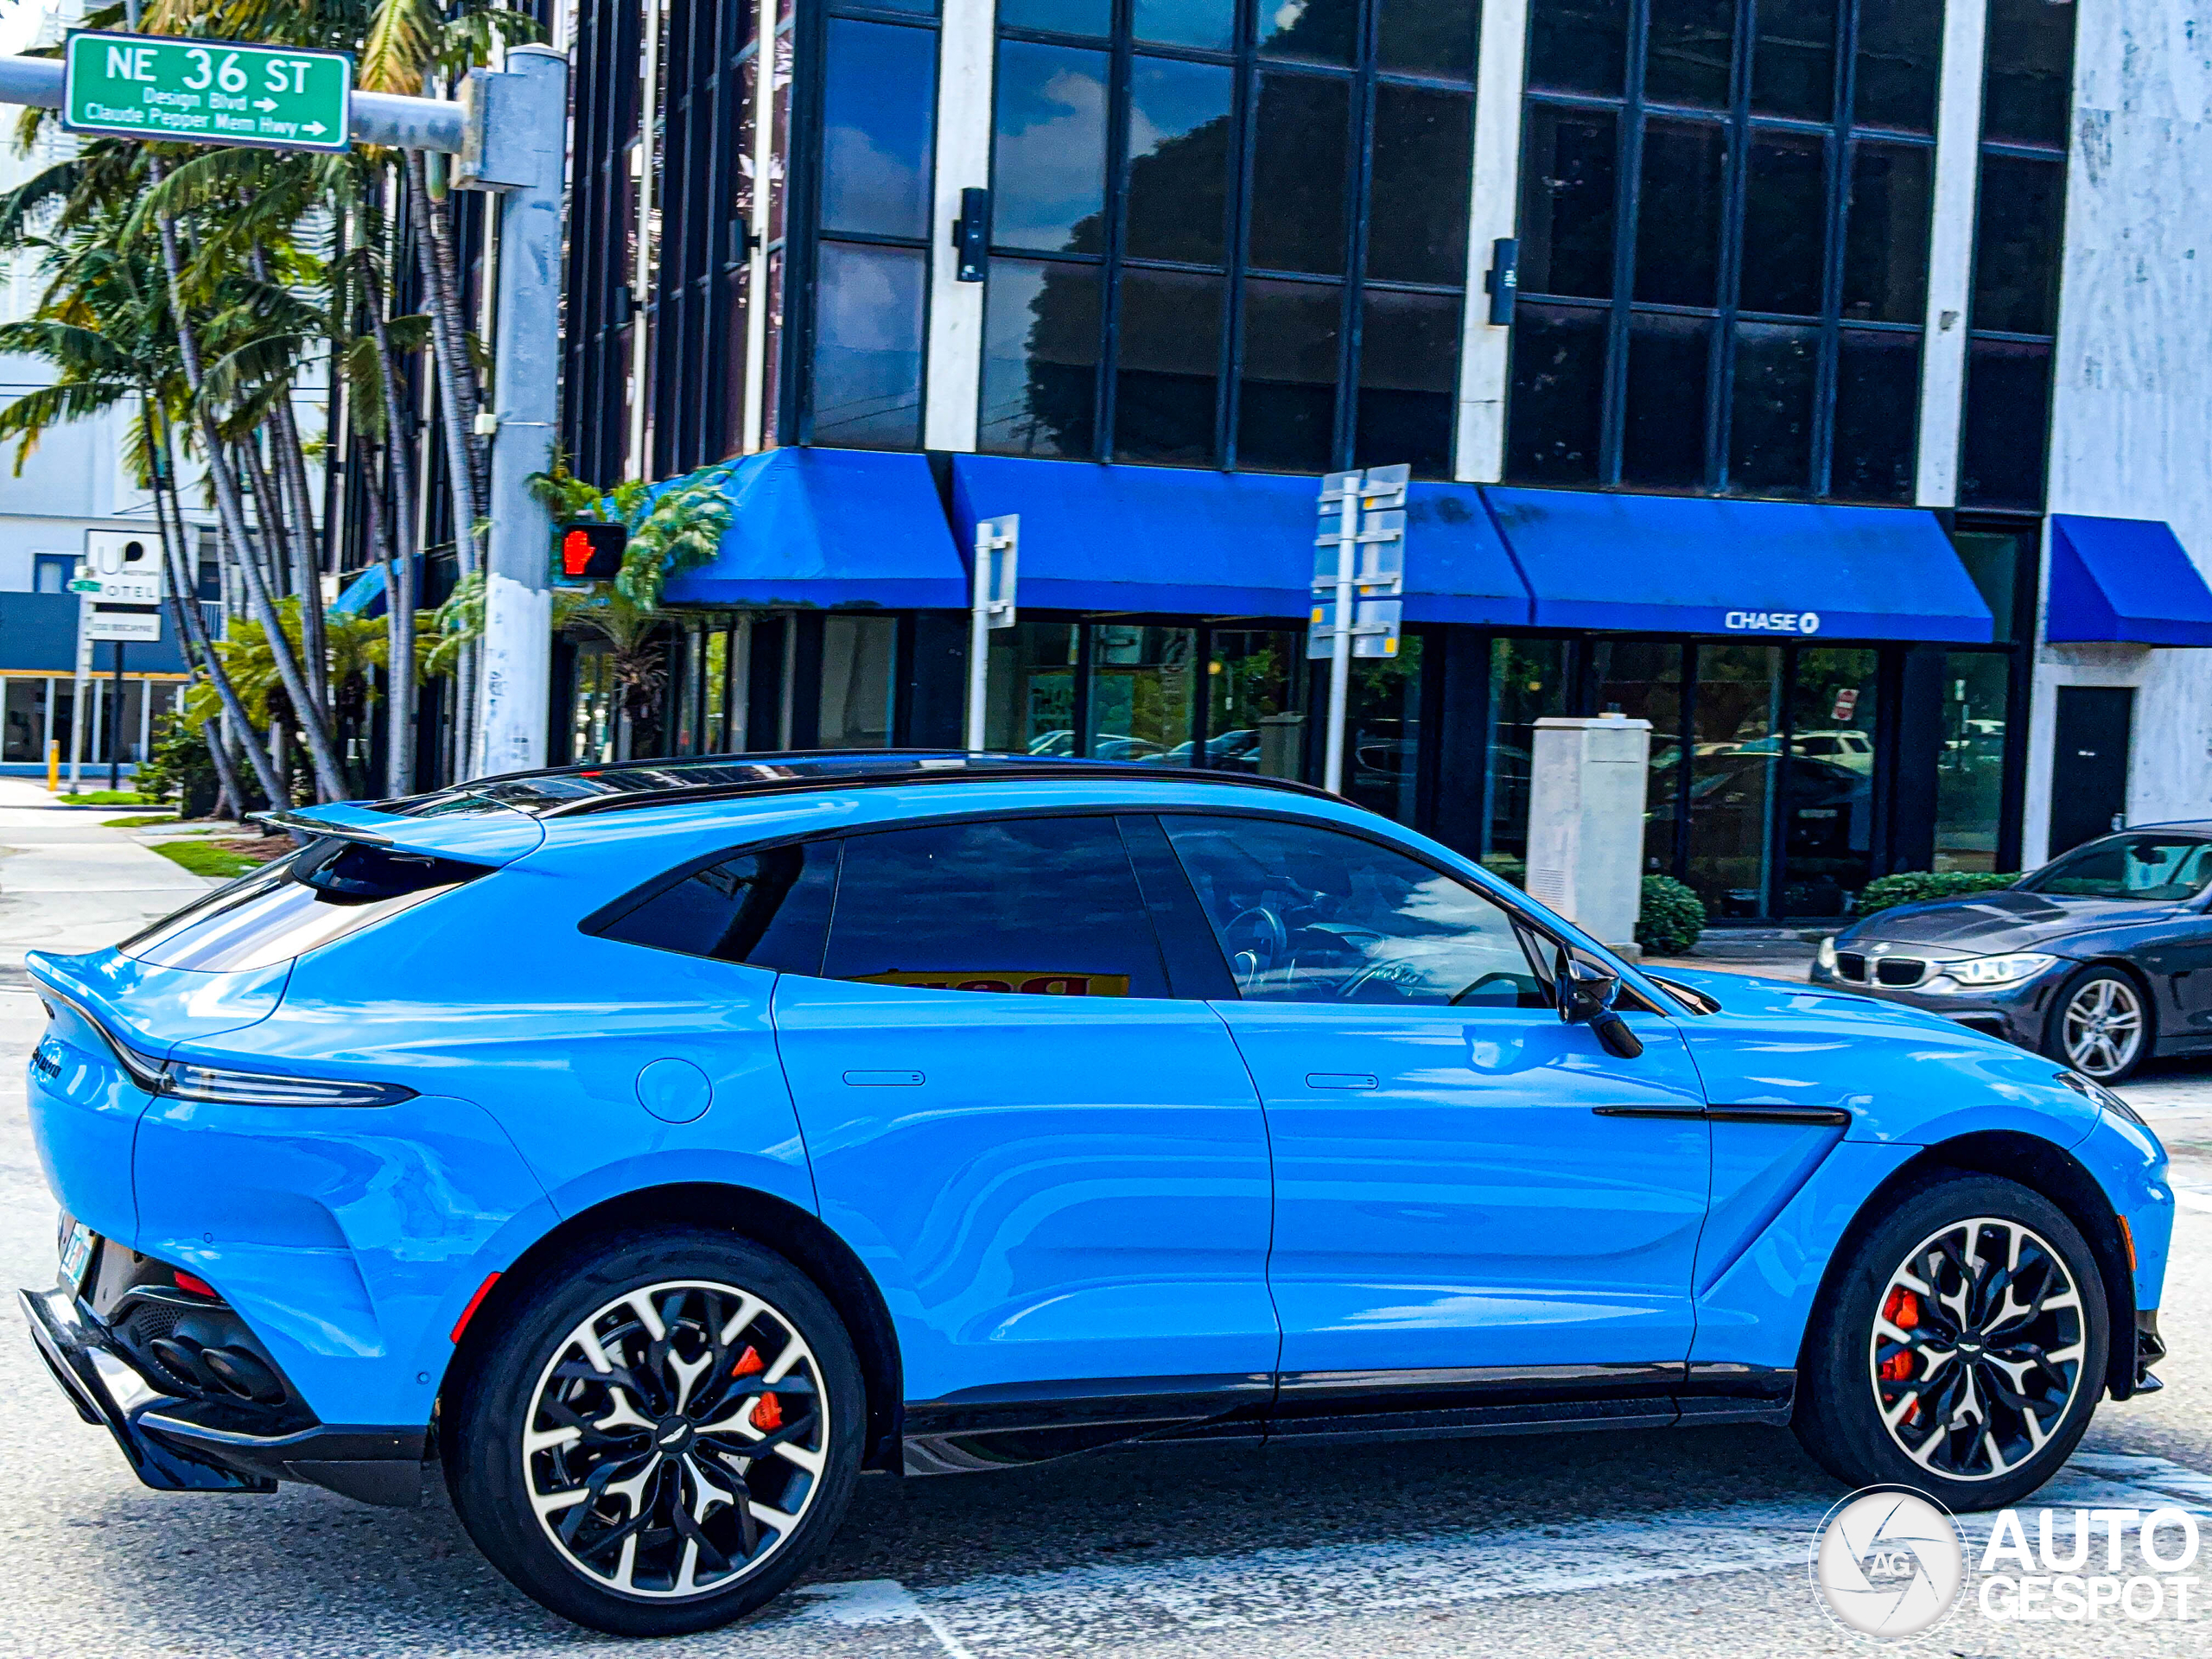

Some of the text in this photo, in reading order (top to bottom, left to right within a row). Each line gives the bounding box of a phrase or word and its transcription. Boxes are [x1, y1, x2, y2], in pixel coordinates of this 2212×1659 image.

[105, 46, 313, 94] NE 36 ST
[143, 86, 248, 111] Design Blvd
[85, 102, 144, 123] Claude
[149, 107, 211, 130] Pepper
[258, 116, 300, 138] Hwy
[105, 585, 156, 598] OTEL
[1725, 611, 1798, 632] CHASE
